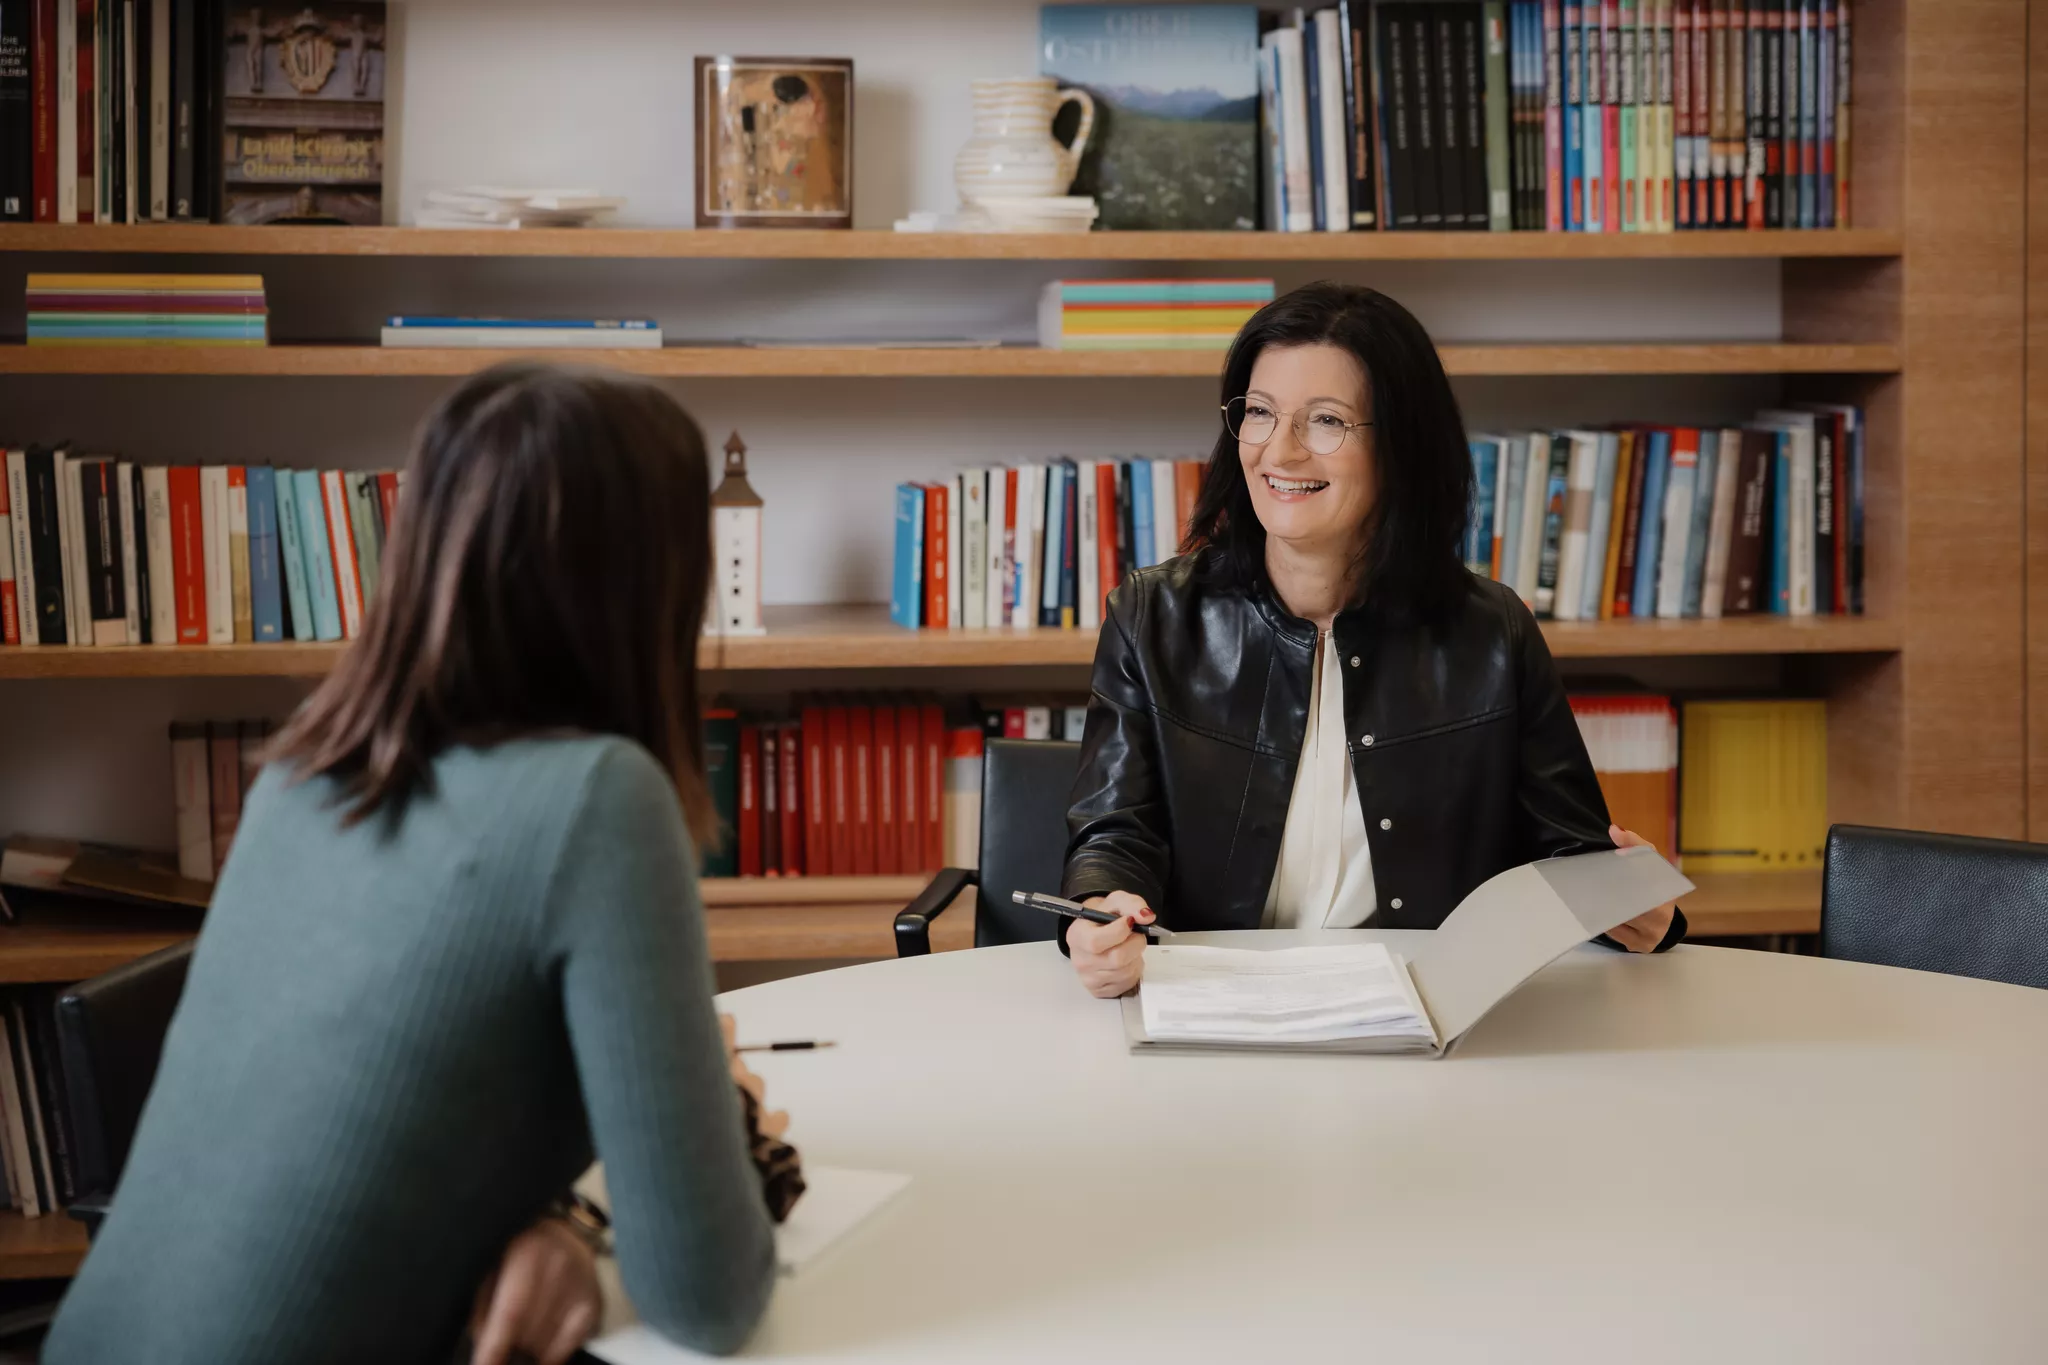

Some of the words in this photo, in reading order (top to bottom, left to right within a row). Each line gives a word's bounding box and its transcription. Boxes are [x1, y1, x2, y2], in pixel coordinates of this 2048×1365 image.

[2, 35, 19, 45] DIE
[0, 57, 21, 66] DER
[0, 67, 28, 77] ILDER
[176, 197, 189, 216] 2
